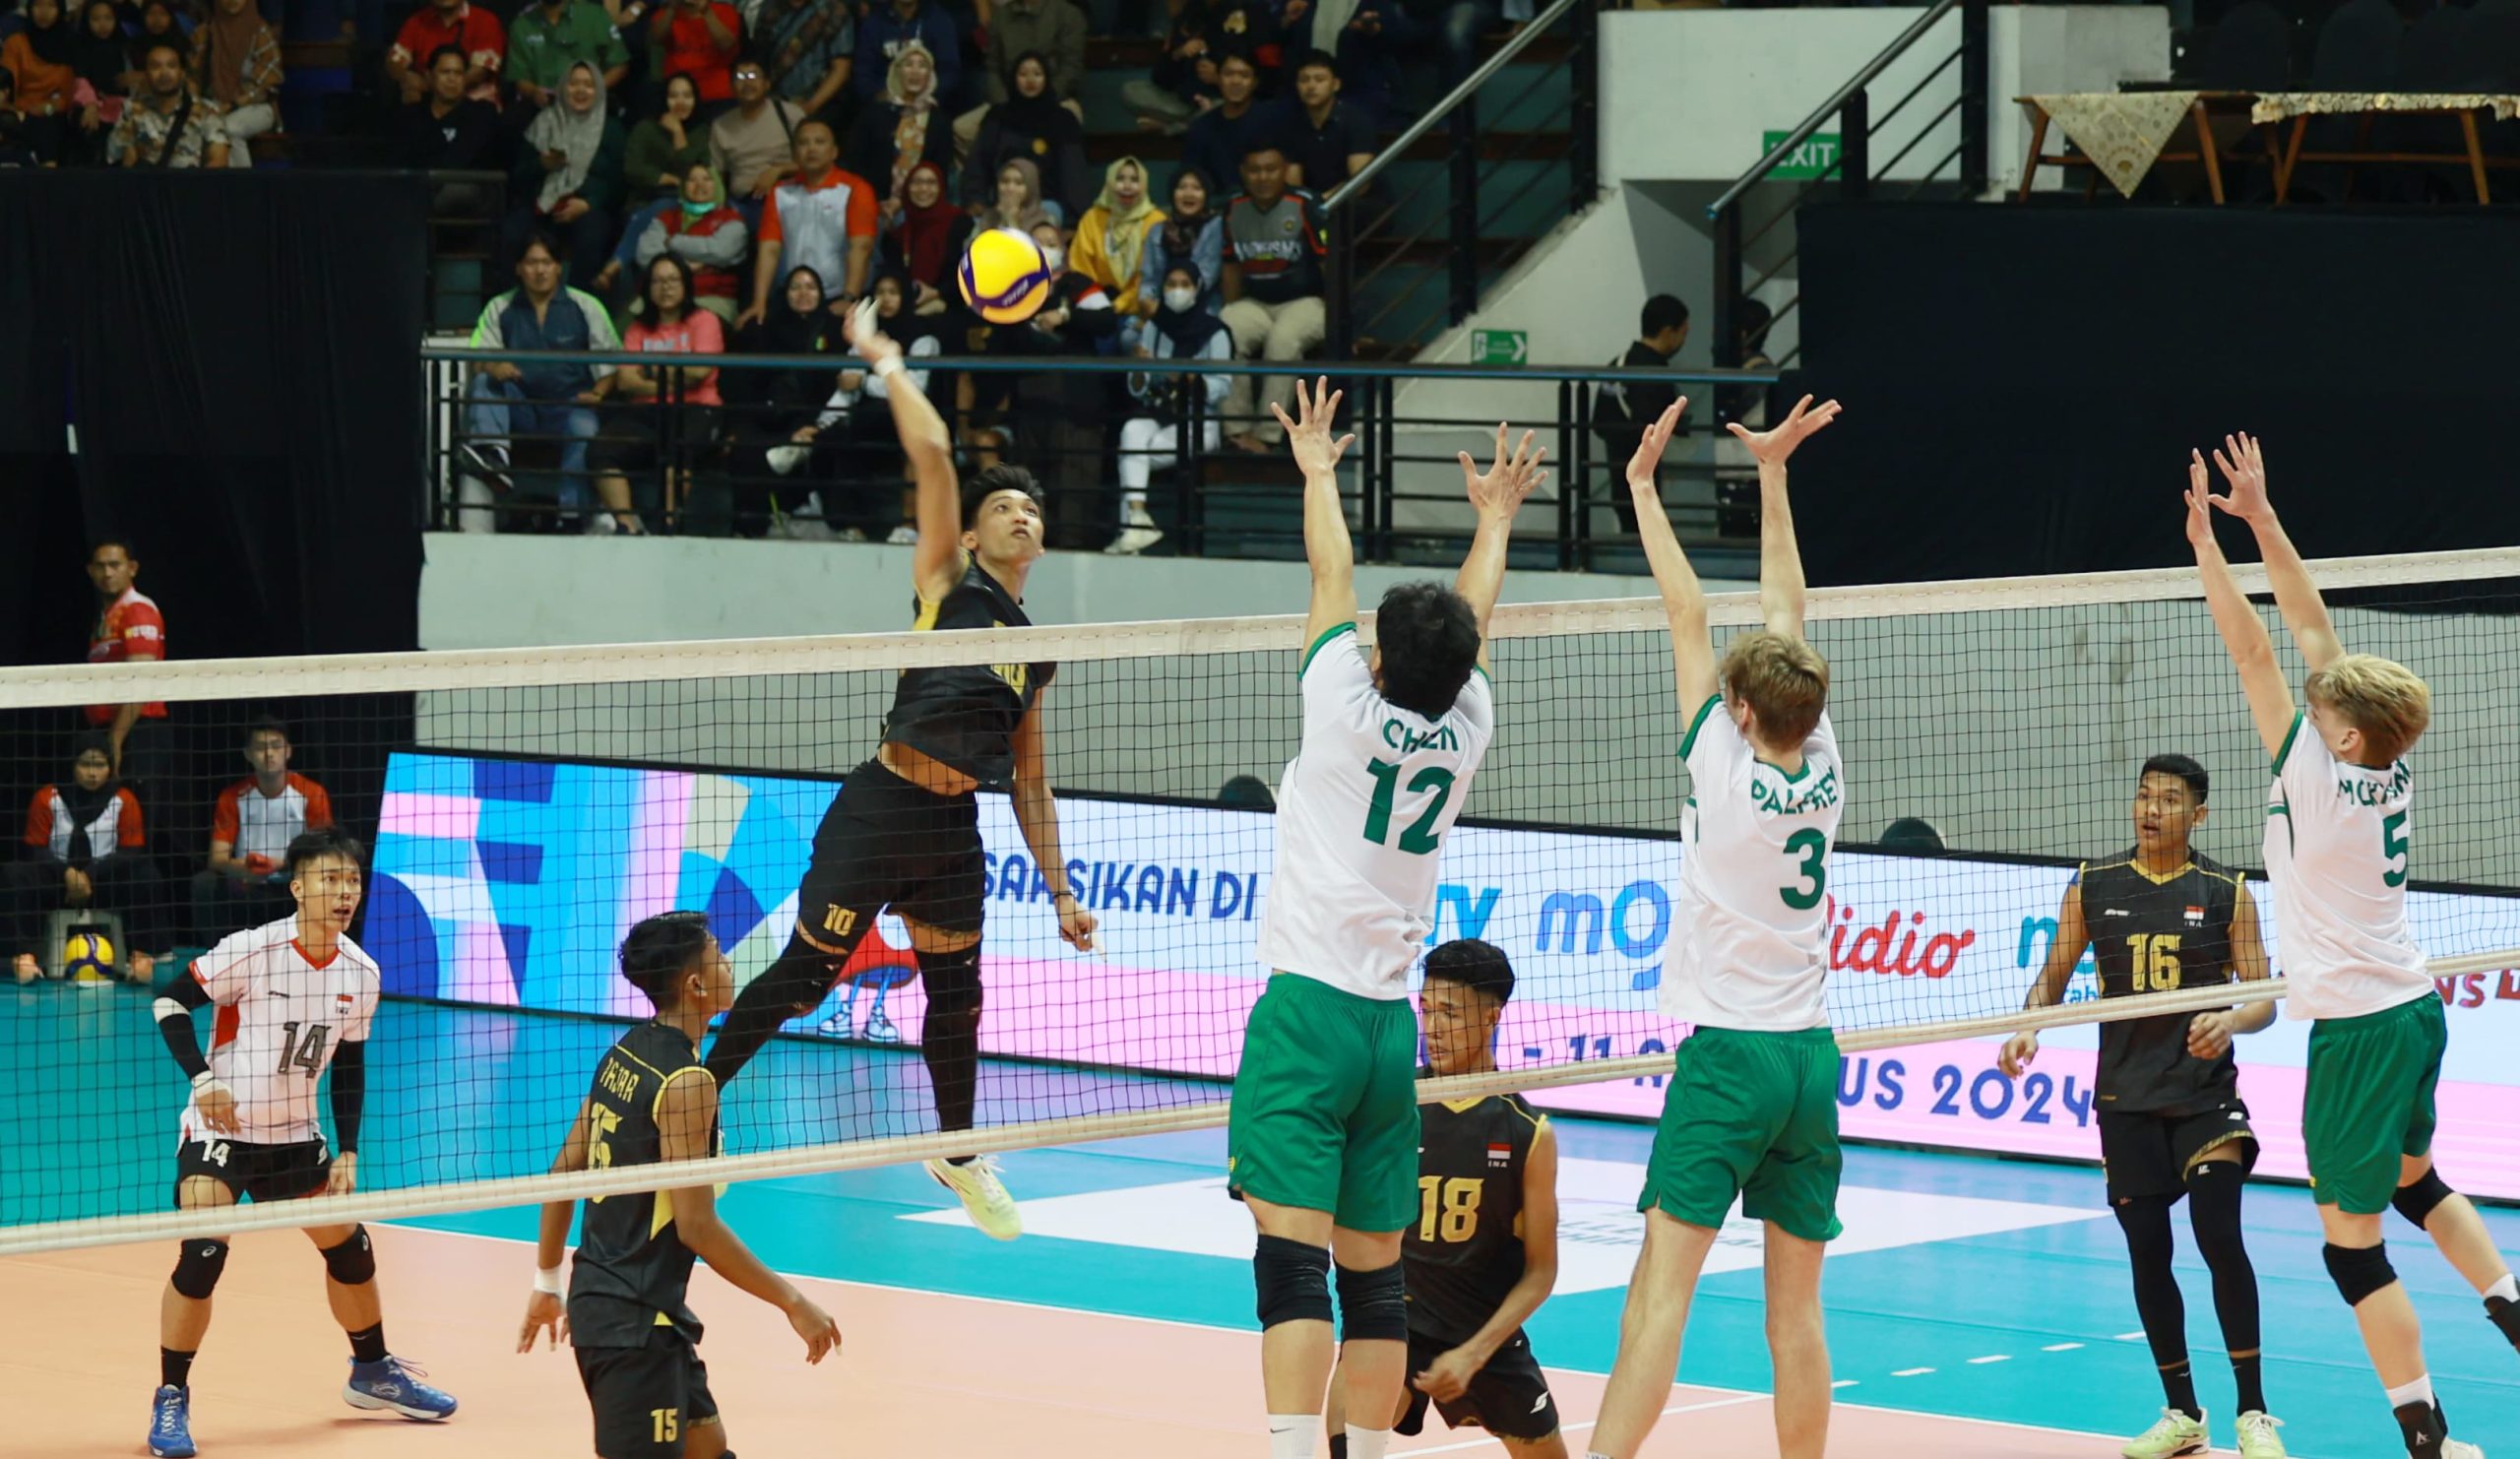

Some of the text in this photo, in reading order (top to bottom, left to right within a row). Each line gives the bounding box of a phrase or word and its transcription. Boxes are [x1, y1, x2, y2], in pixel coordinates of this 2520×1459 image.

[1362, 756, 1457, 855] 12
[1779, 827, 1827, 911] 3
[2382, 807, 2409, 888] 5
[823, 903, 858, 937] 10
[1210, 870, 1258, 921] DI
[1827, 893, 1976, 979] idio
[2126, 933, 2182, 992] 16
[278, 1021, 333, 1080] 14
[1929, 1064, 2092, 1128] 2024
[201, 1139, 231, 1169] 14
[1487, 1160, 1508, 1169] INA
[1418, 1175, 1485, 1243] 18
[650, 1408, 678, 1443] 15
